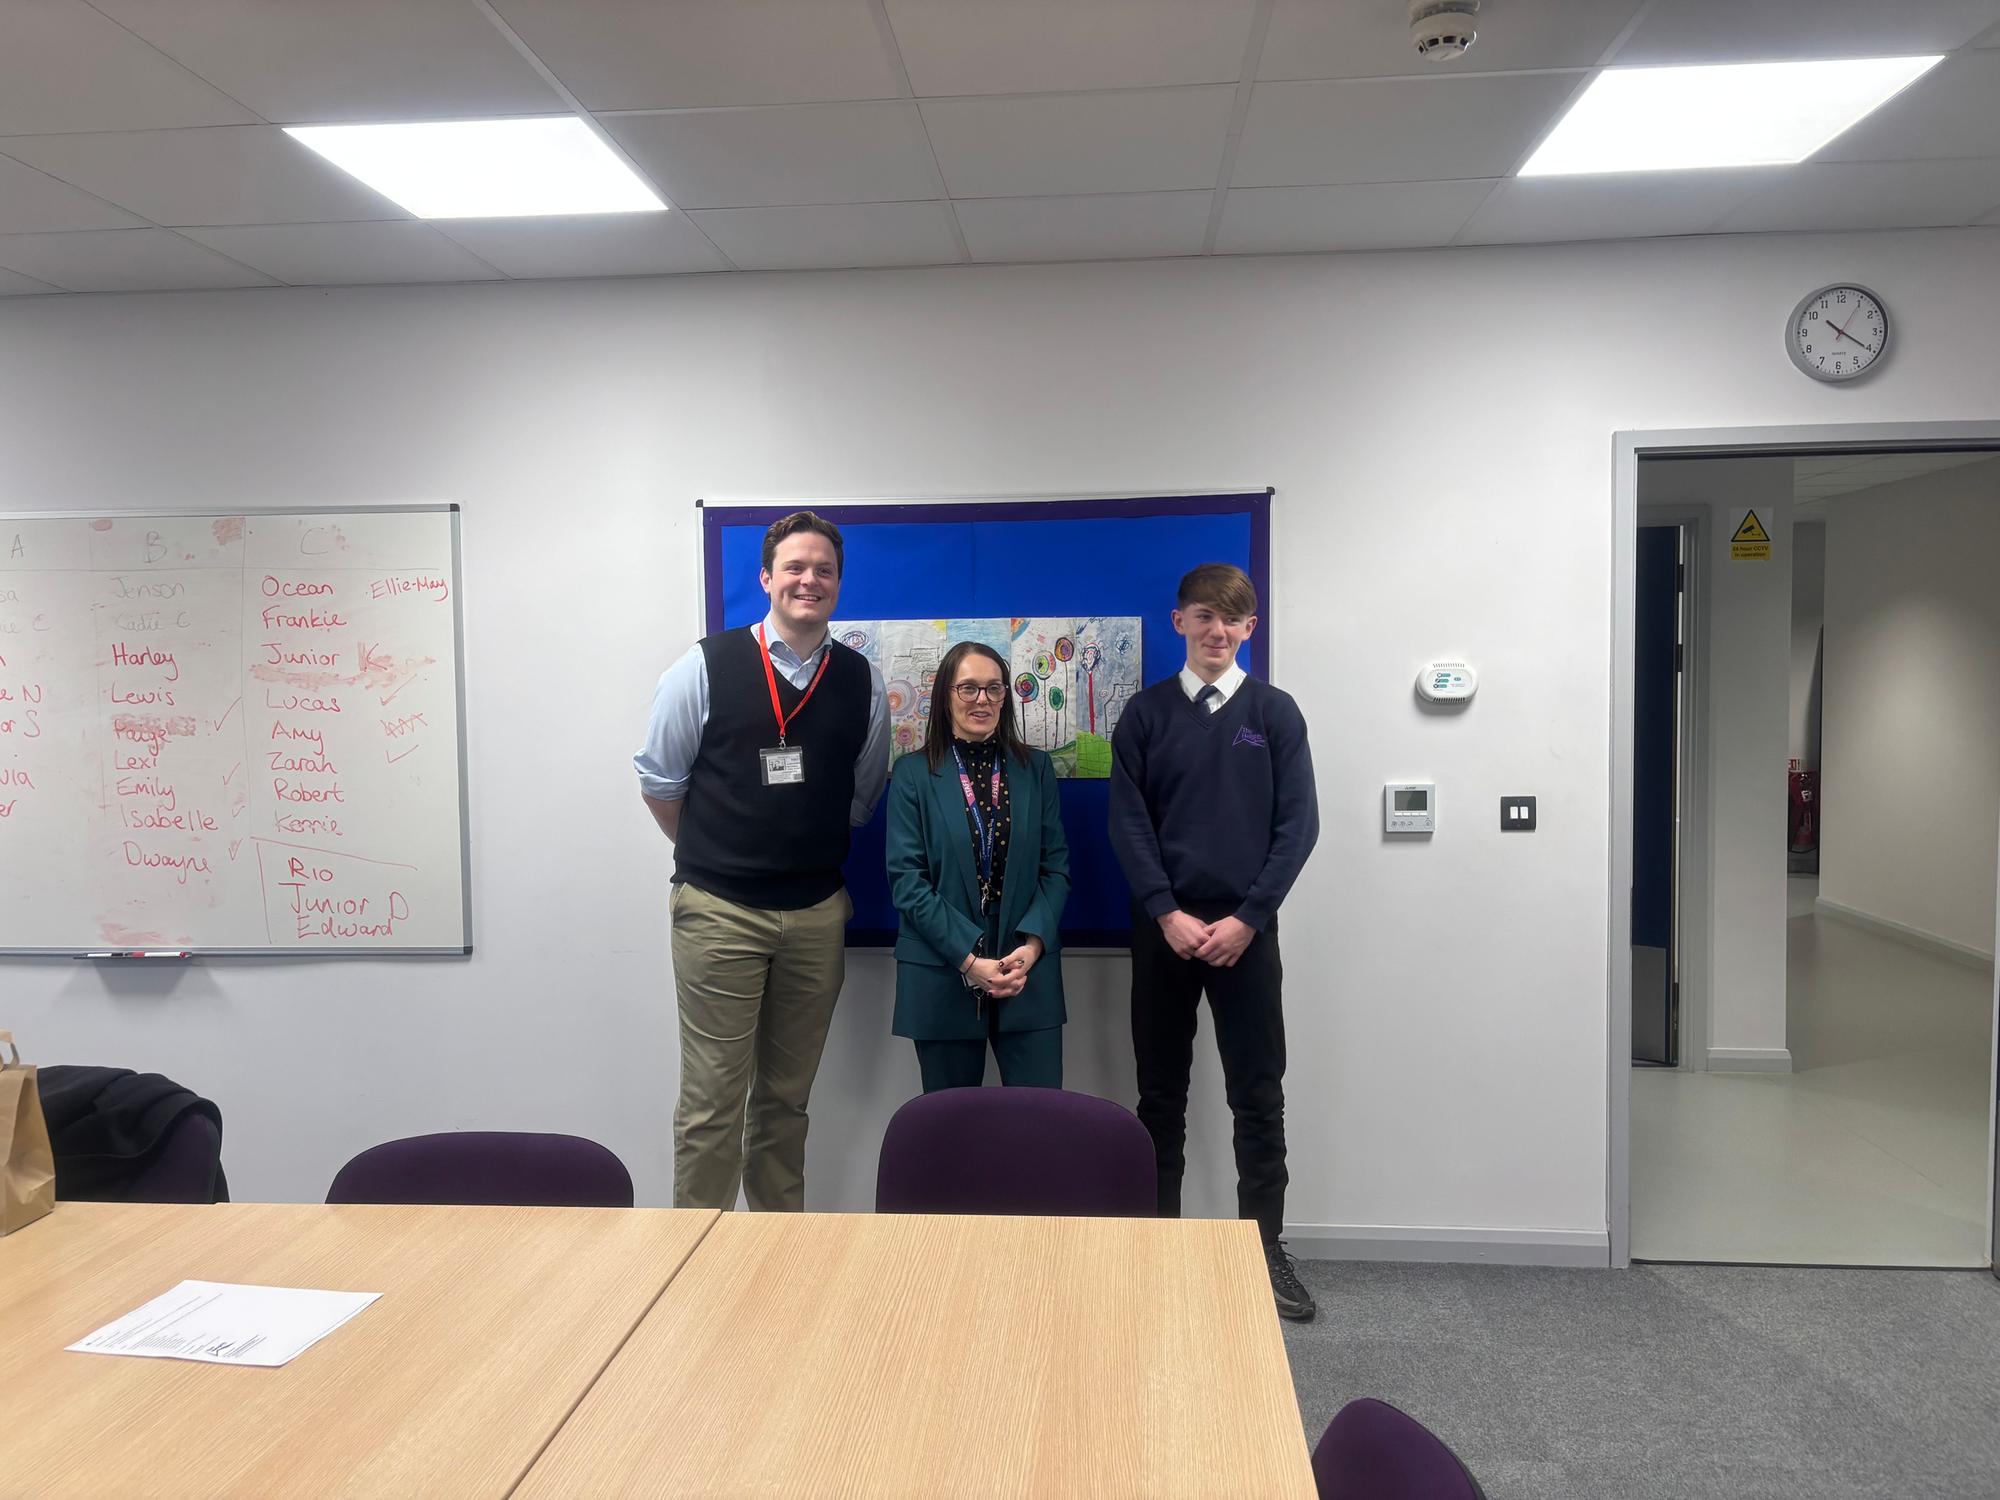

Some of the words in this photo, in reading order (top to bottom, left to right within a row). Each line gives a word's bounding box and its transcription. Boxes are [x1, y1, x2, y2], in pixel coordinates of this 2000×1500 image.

[1821, 300, 1828, 309] 11
[1837, 295, 1846, 303] 12
[1809, 312, 1819, 320] 10
[1867, 311, 1873, 319] 2
[1802, 329, 1808, 337] 9
[1872, 328, 1878, 336] 3
[1806, 345, 1812, 353] 8
[1819, 356, 1825, 365] 7
[1836, 362, 1842, 370] 6
[1853, 356, 1859, 365] 5
[11, 534, 24, 559] A
[144, 531, 167, 563] B
[110, 577, 185, 599] Jenson
[261, 575, 334, 597] Ocean
[262, 605, 347, 629] Frankie
[112, 642, 179, 681] Harley
[261, 643, 341, 666] Junior
[111, 682, 175, 706] Lewis
[266, 689, 341, 712] Lucas
[271, 721, 323, 755] Amy
[267, 752, 338, 774] Zarah
[116, 777, 176, 811] Emily
[274, 778, 344, 802] Robert
[123, 841, 212, 884] Dwayne
[278, 882, 369, 915] Junior
[297, 915, 393, 938] Edward
